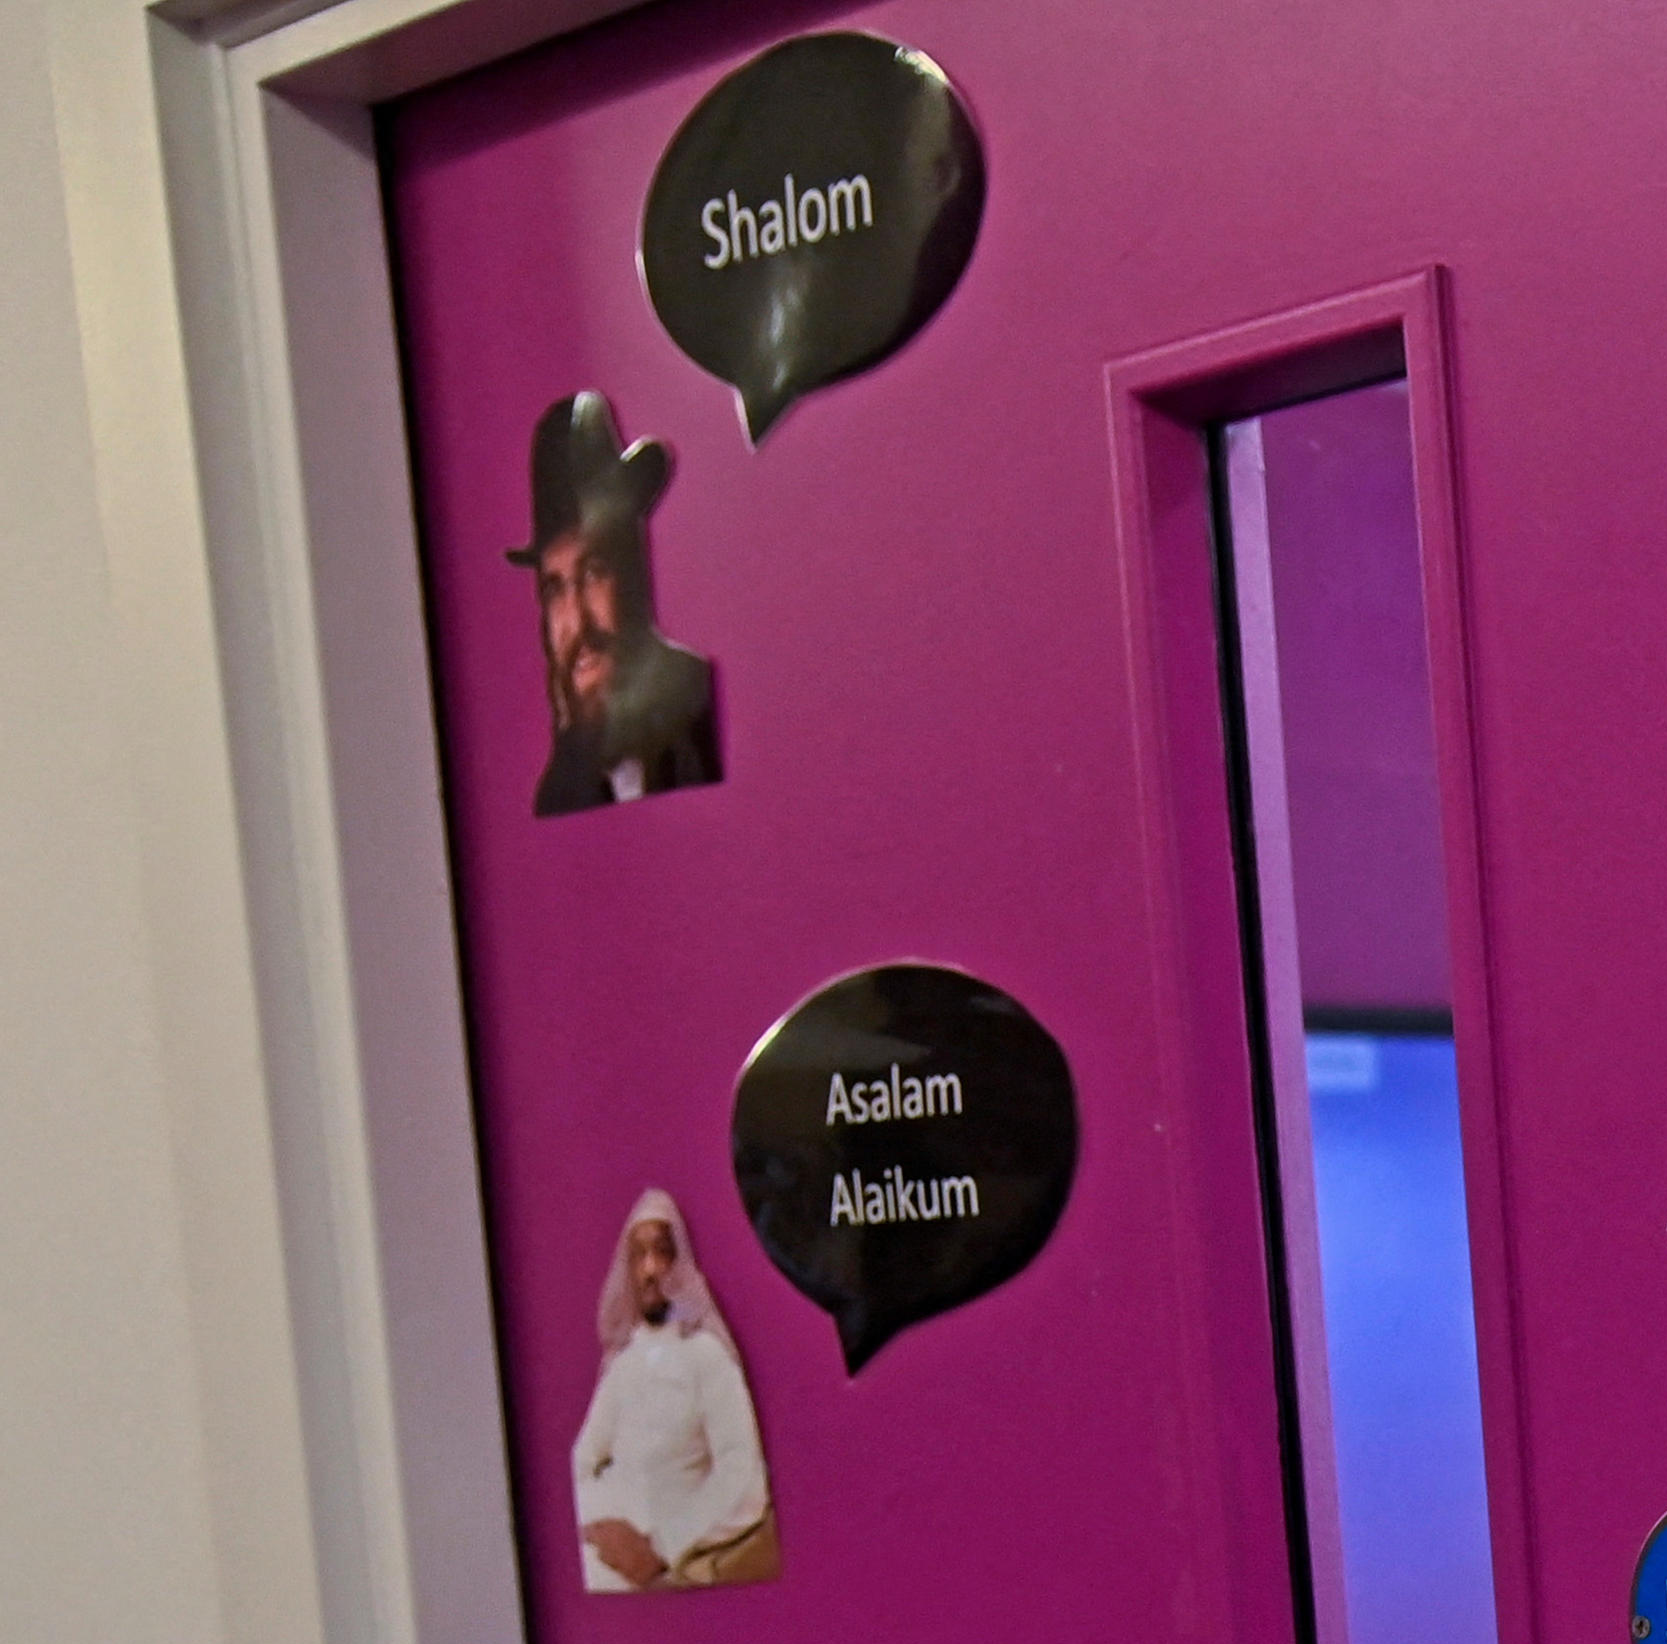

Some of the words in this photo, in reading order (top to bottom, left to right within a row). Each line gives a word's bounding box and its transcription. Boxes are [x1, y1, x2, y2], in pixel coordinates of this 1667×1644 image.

[701, 173, 873, 270] Shalom
[826, 1062, 962, 1126] Asalam
[830, 1165, 979, 1227] Alaikum
